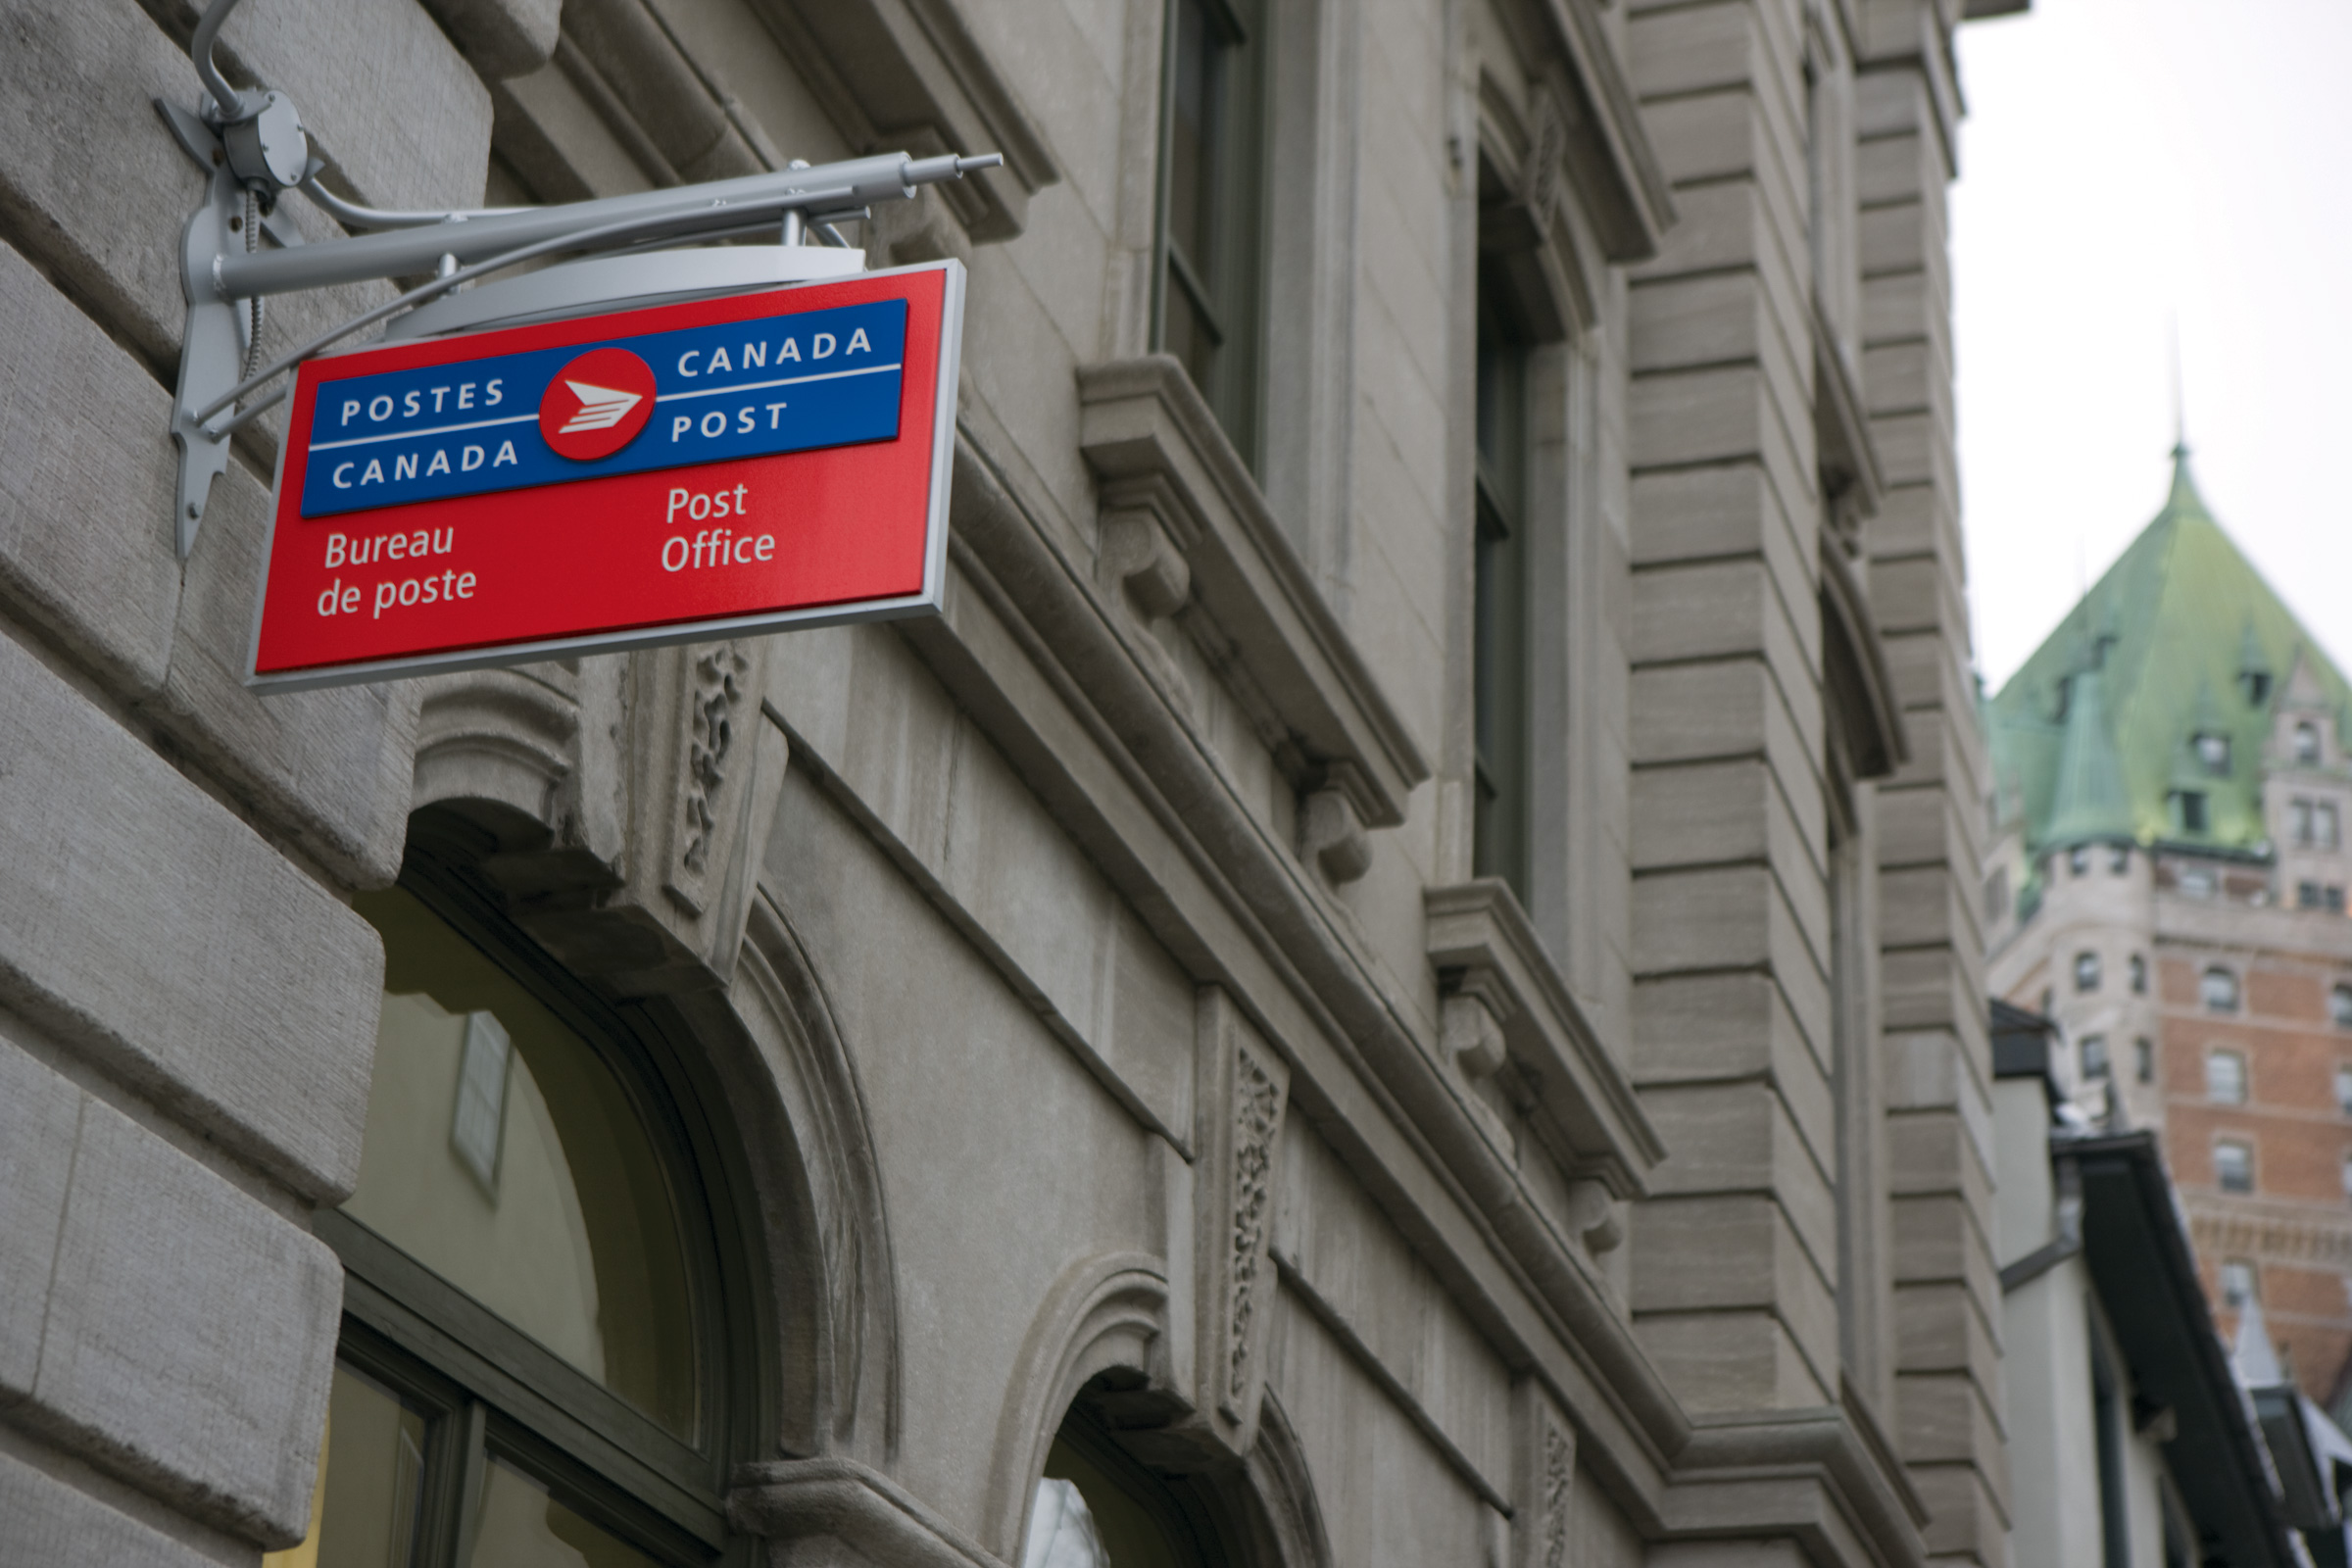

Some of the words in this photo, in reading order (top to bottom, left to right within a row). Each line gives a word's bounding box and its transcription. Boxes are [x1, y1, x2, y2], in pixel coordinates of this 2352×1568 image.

[677, 326, 873, 378] CANADA
[340, 378, 505, 426] POSTES
[671, 402, 789, 443] POST
[332, 439, 519, 489] CANADA
[666, 482, 749, 524] Post
[324, 526, 455, 569] Bureau
[662, 528, 776, 572] Office
[317, 578, 362, 617] de
[373, 569, 477, 619] poste
